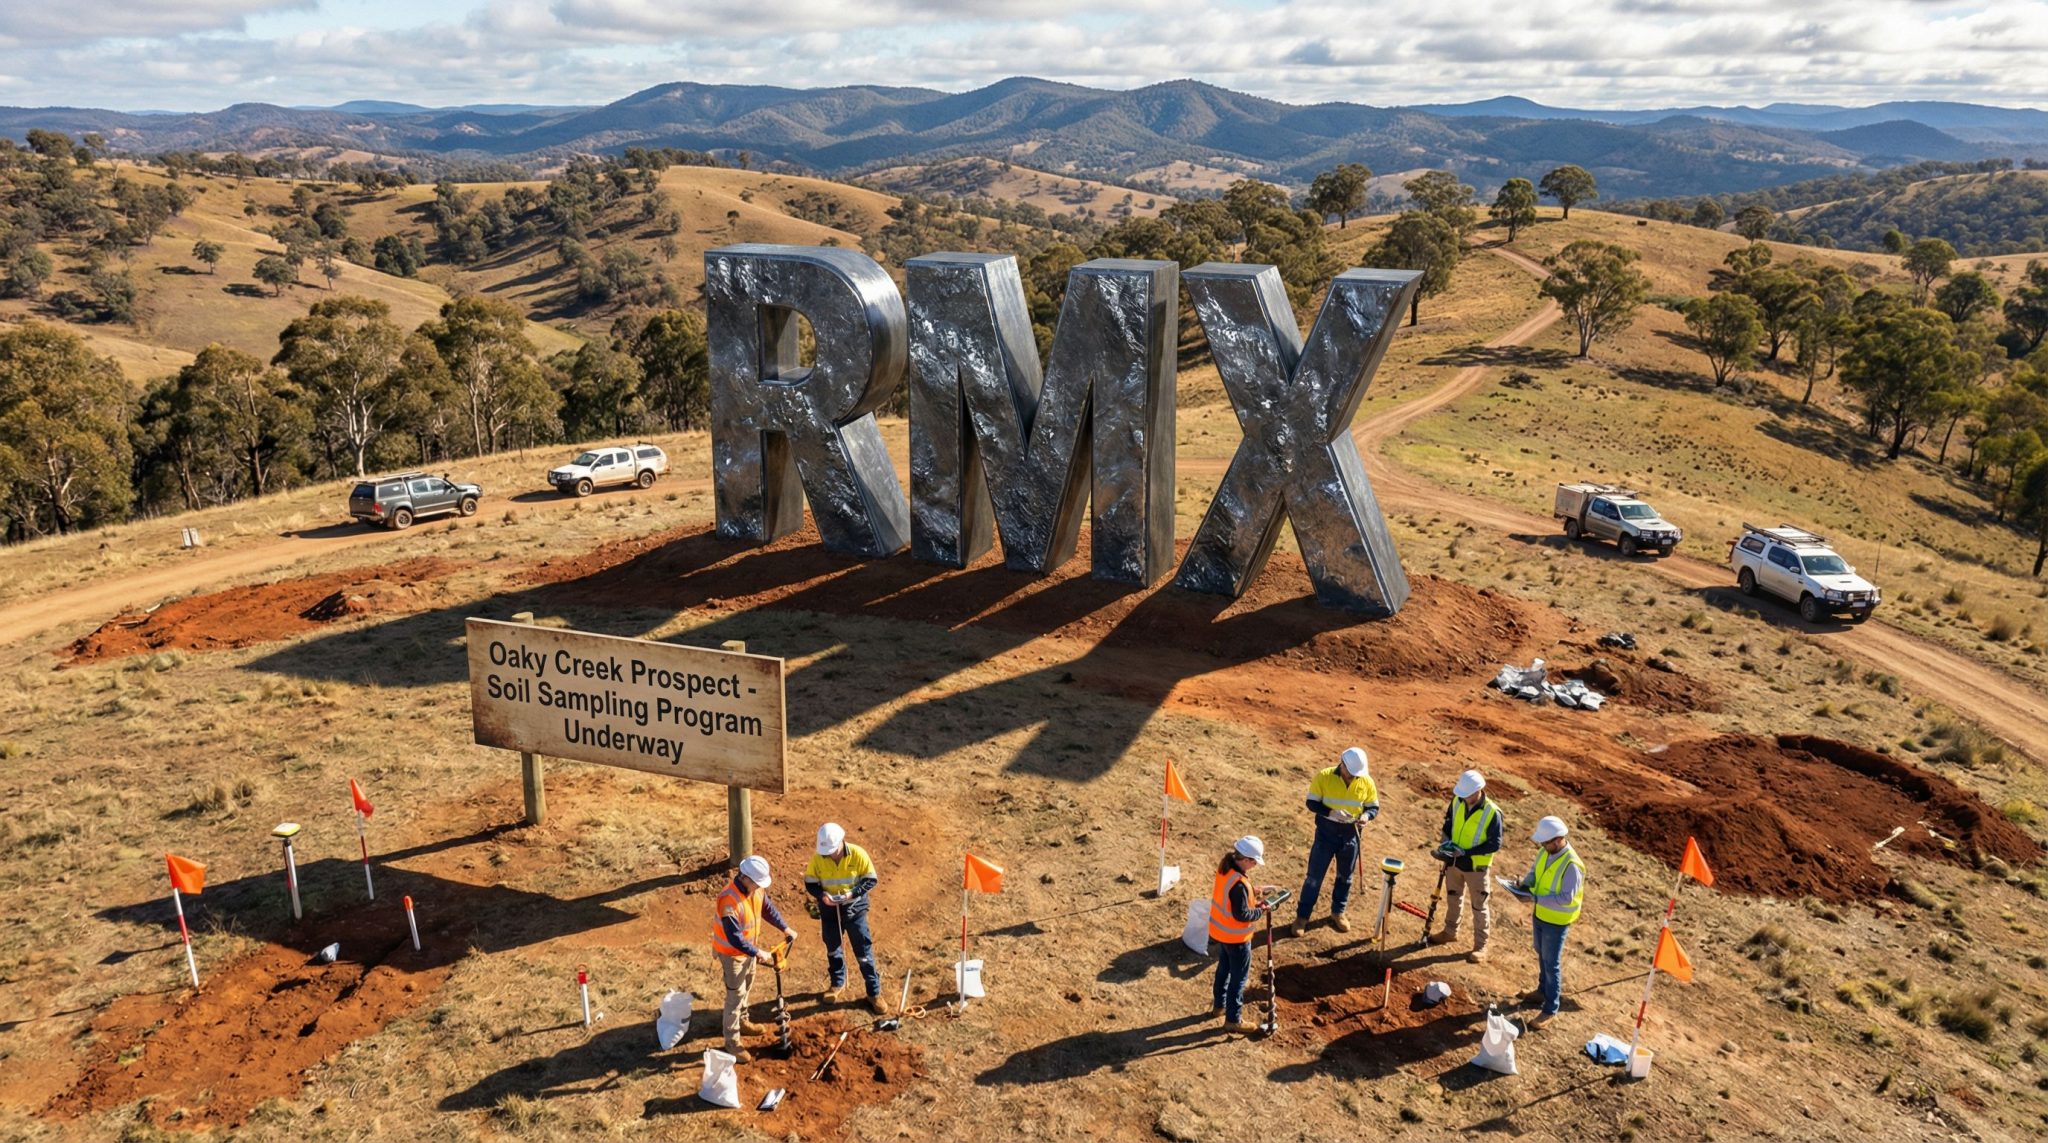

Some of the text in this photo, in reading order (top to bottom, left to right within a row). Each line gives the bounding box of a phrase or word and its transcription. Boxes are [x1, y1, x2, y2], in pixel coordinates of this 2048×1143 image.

[704, 244, 1423, 619] RMX
[489, 641, 546, 677] Oaky
[555, 649, 623, 682] Creek
[631, 659, 740, 698] Prospect
[488, 674, 762, 736] Soil Sampling Program
[565, 718, 684, 764] Underway
